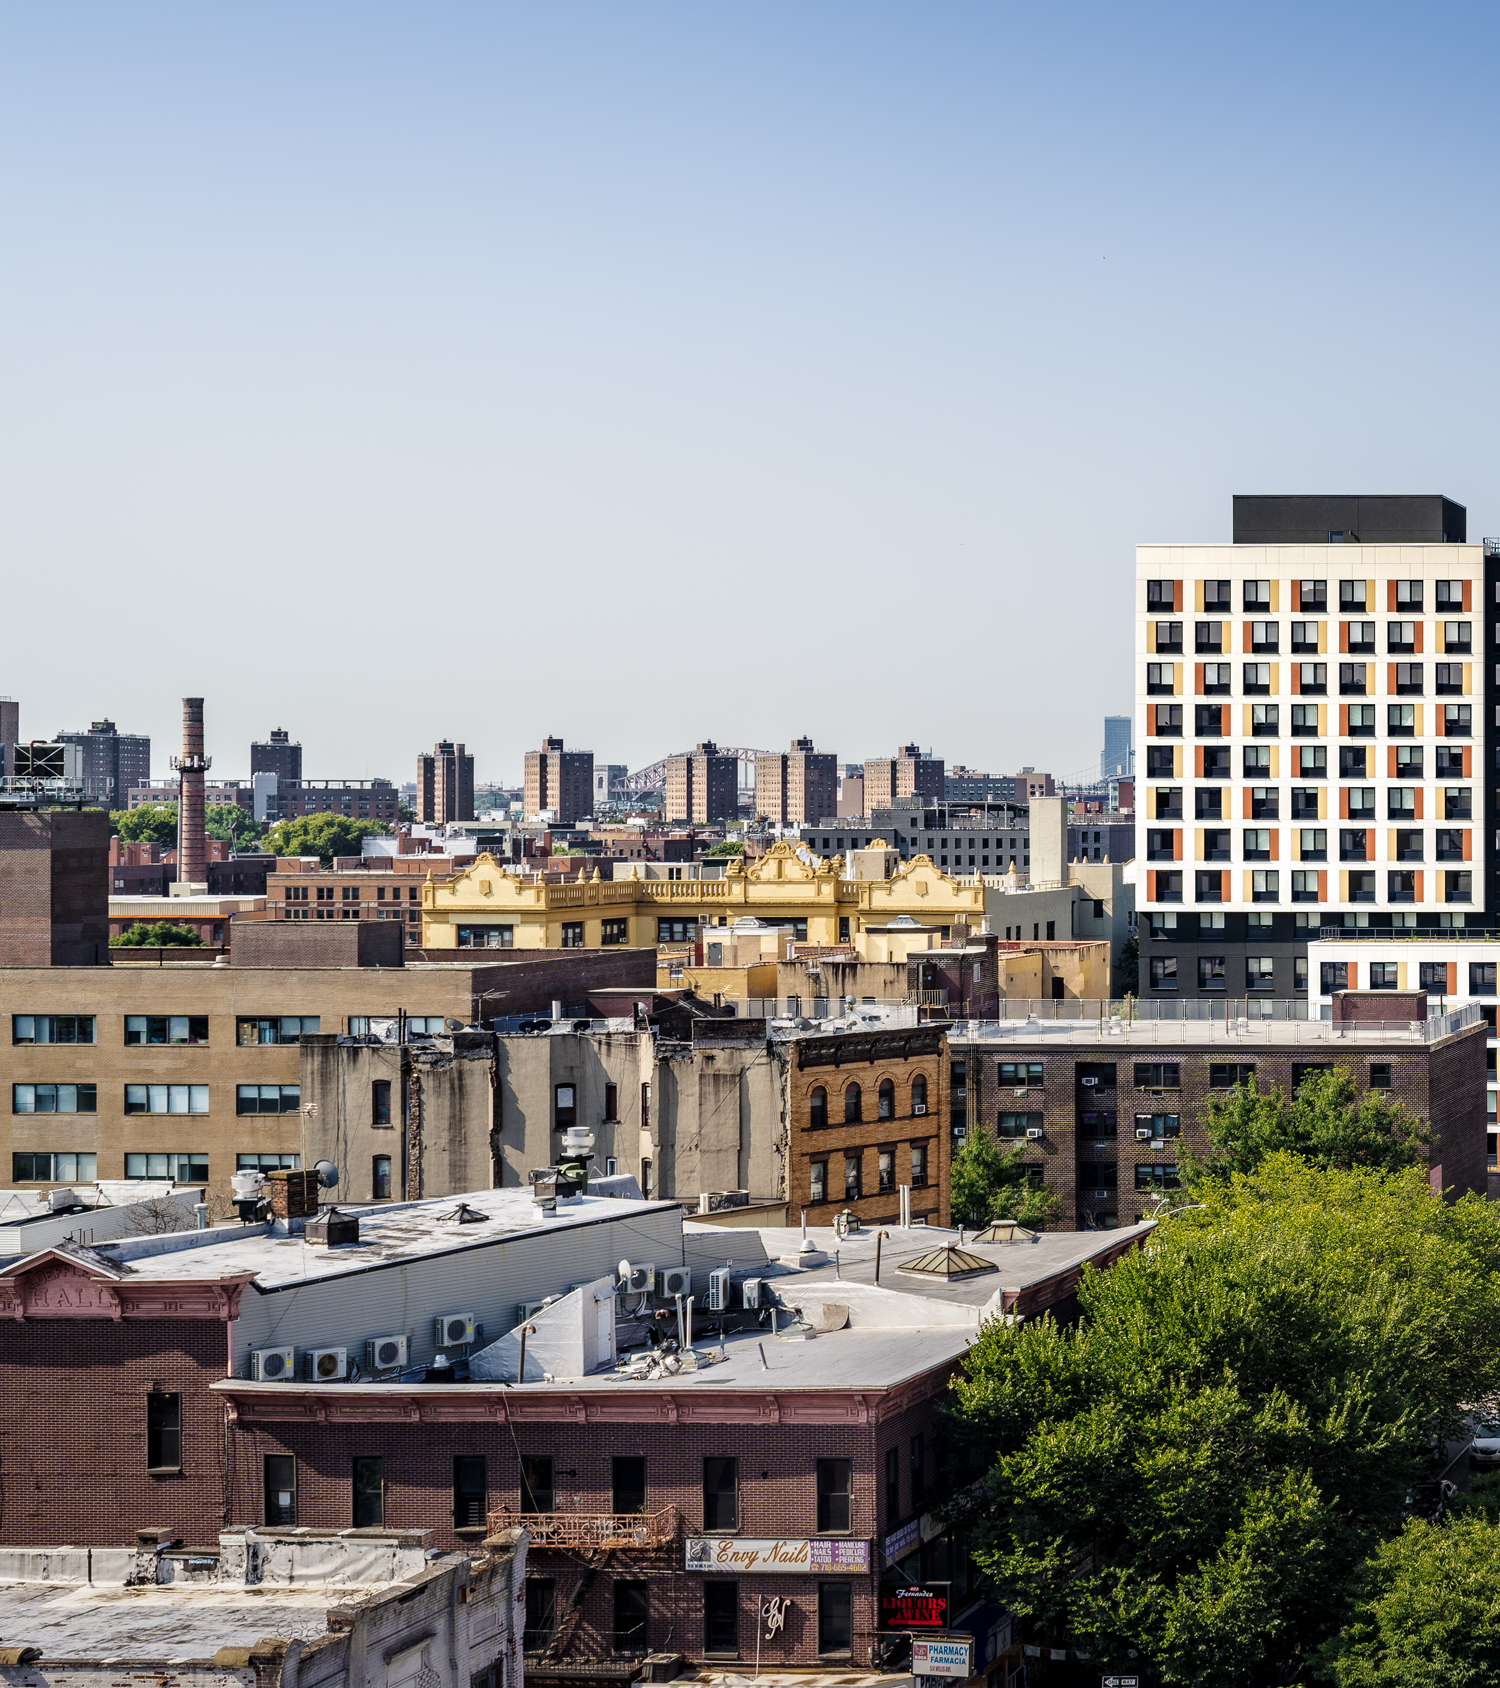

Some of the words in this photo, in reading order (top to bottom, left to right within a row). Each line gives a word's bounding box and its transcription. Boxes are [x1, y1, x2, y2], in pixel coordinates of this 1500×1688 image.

[813, 1541, 832, 1549] HAIR
[838, 1541, 866, 1549] MANICURE
[716, 1540, 759, 1570] Envy
[763, 1540, 809, 1564] Nails
[813, 1548, 832, 1556] NAILS
[838, 1548, 866, 1556] PEDICURE
[813, 1555, 832, 1563] TATOO
[896, 1588, 934, 1598] Fernandez
[882, 1597, 947, 1610] LIQUORS
[902, 1609, 941, 1620] WINE
[928, 1645, 969, 1656] PHARMACY
[930, 1656, 967, 1665] FARMACIA
